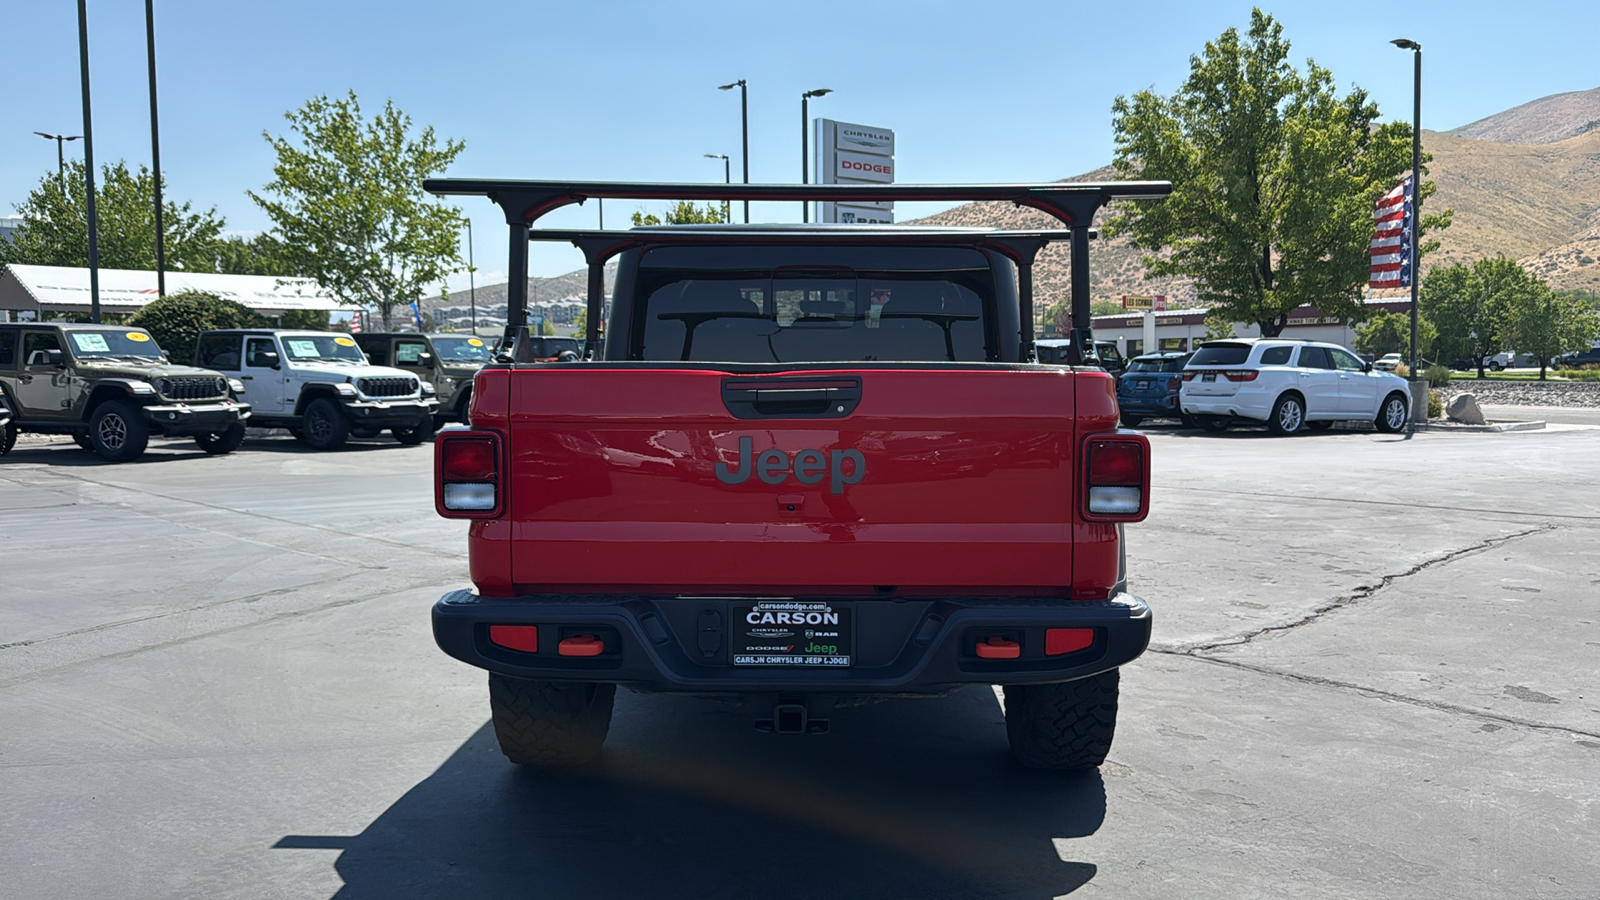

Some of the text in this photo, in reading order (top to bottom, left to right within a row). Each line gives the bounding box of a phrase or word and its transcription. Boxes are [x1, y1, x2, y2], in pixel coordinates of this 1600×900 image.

[843, 129, 890, 141] CHRYSLER
[841, 160, 892, 174] DODGE
[1126, 298, 1134, 306] LES
[714, 436, 866, 495] Jeep
[760, 603, 825, 611] carsondodge.com
[746, 612, 839, 625] CARSON
[804, 642, 837, 655] Jeep
[766, 656, 803, 664] CHRYSLER
